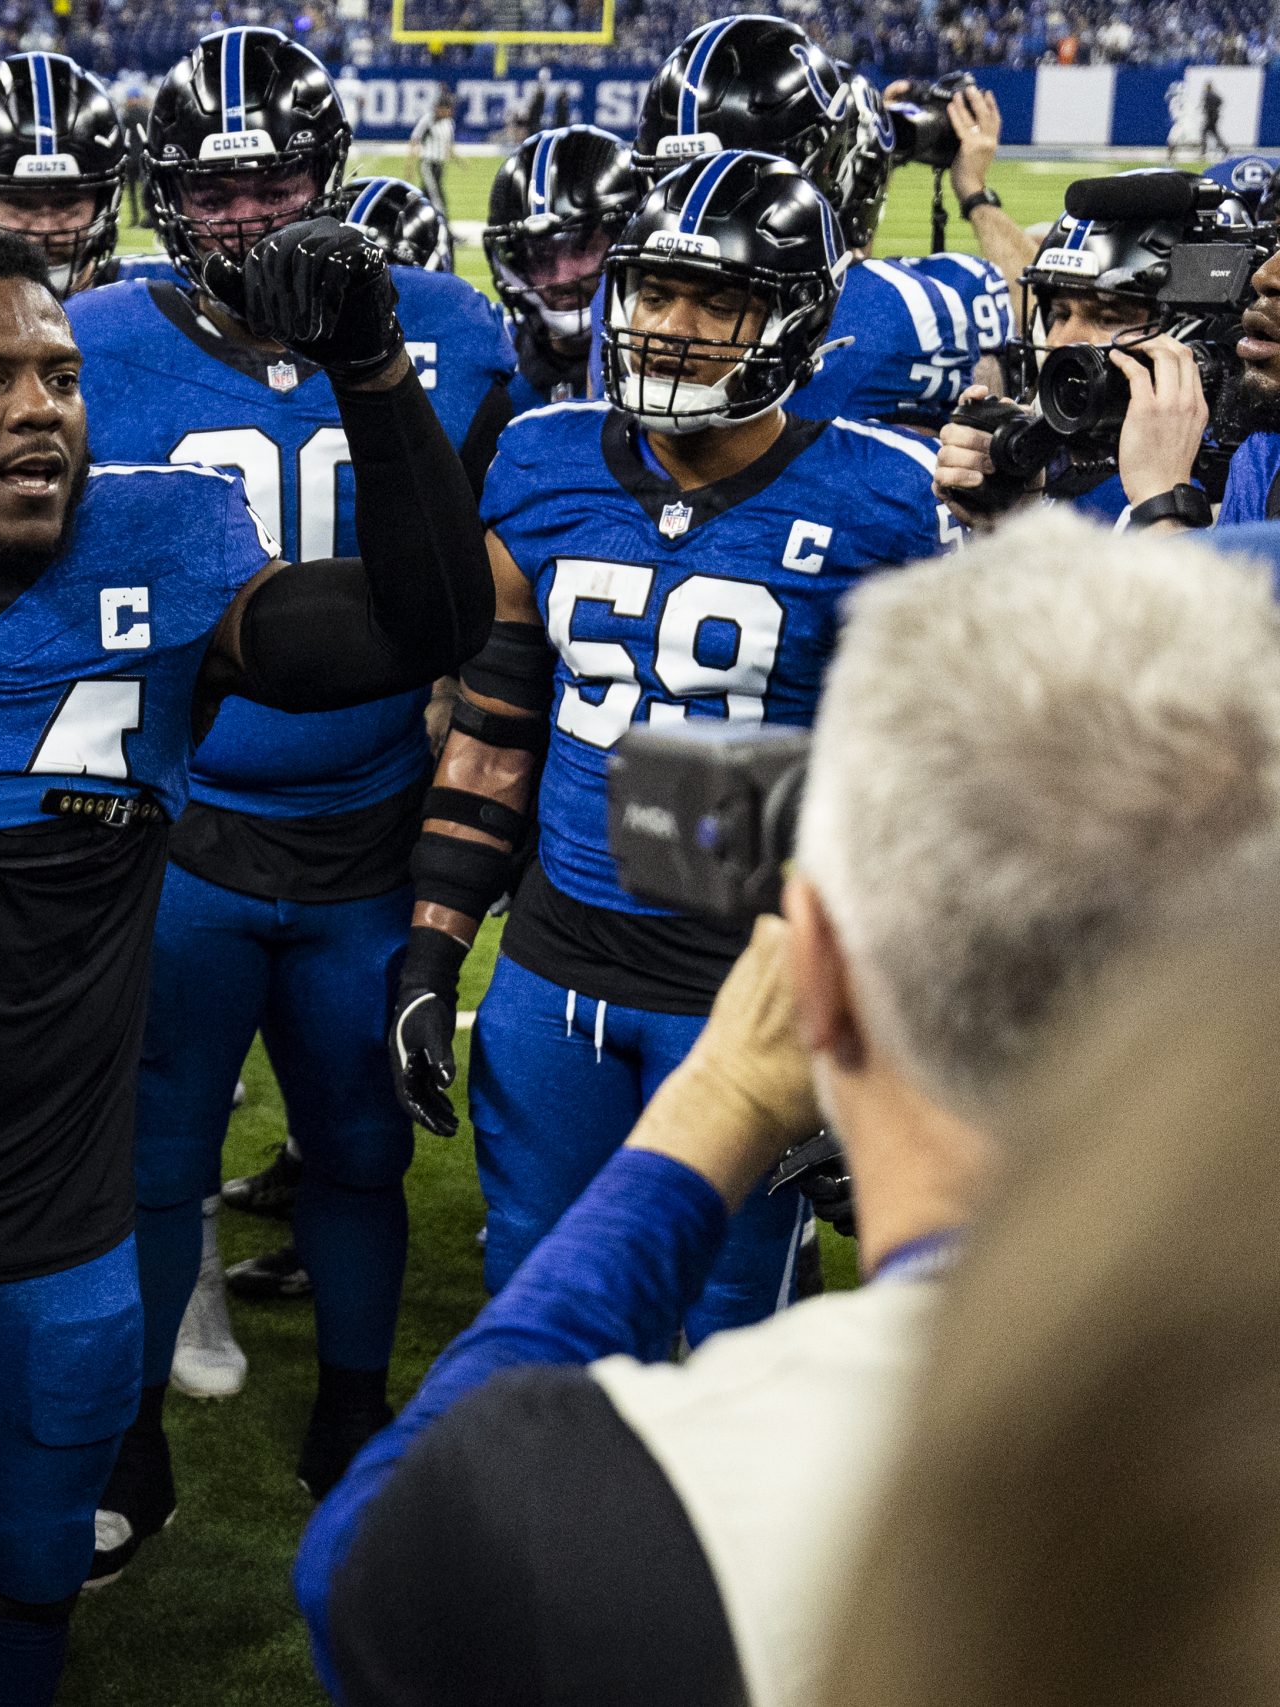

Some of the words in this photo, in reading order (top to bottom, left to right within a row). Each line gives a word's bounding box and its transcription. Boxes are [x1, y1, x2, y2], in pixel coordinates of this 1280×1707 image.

[356, 79, 441, 124] OR
[213, 136, 259, 152] COLTS
[665, 140, 705, 154] COLTS
[27, 160, 67, 172] COLTS
[656, 236, 704, 254] COLTS
[1045, 254, 1083, 268] COLTS
[973, 292, 1015, 349] 97
[909, 363, 961, 402] 71
[782, 519, 833, 574] C
[100, 587, 151, 650] C
[548, 558, 784, 748] 59
